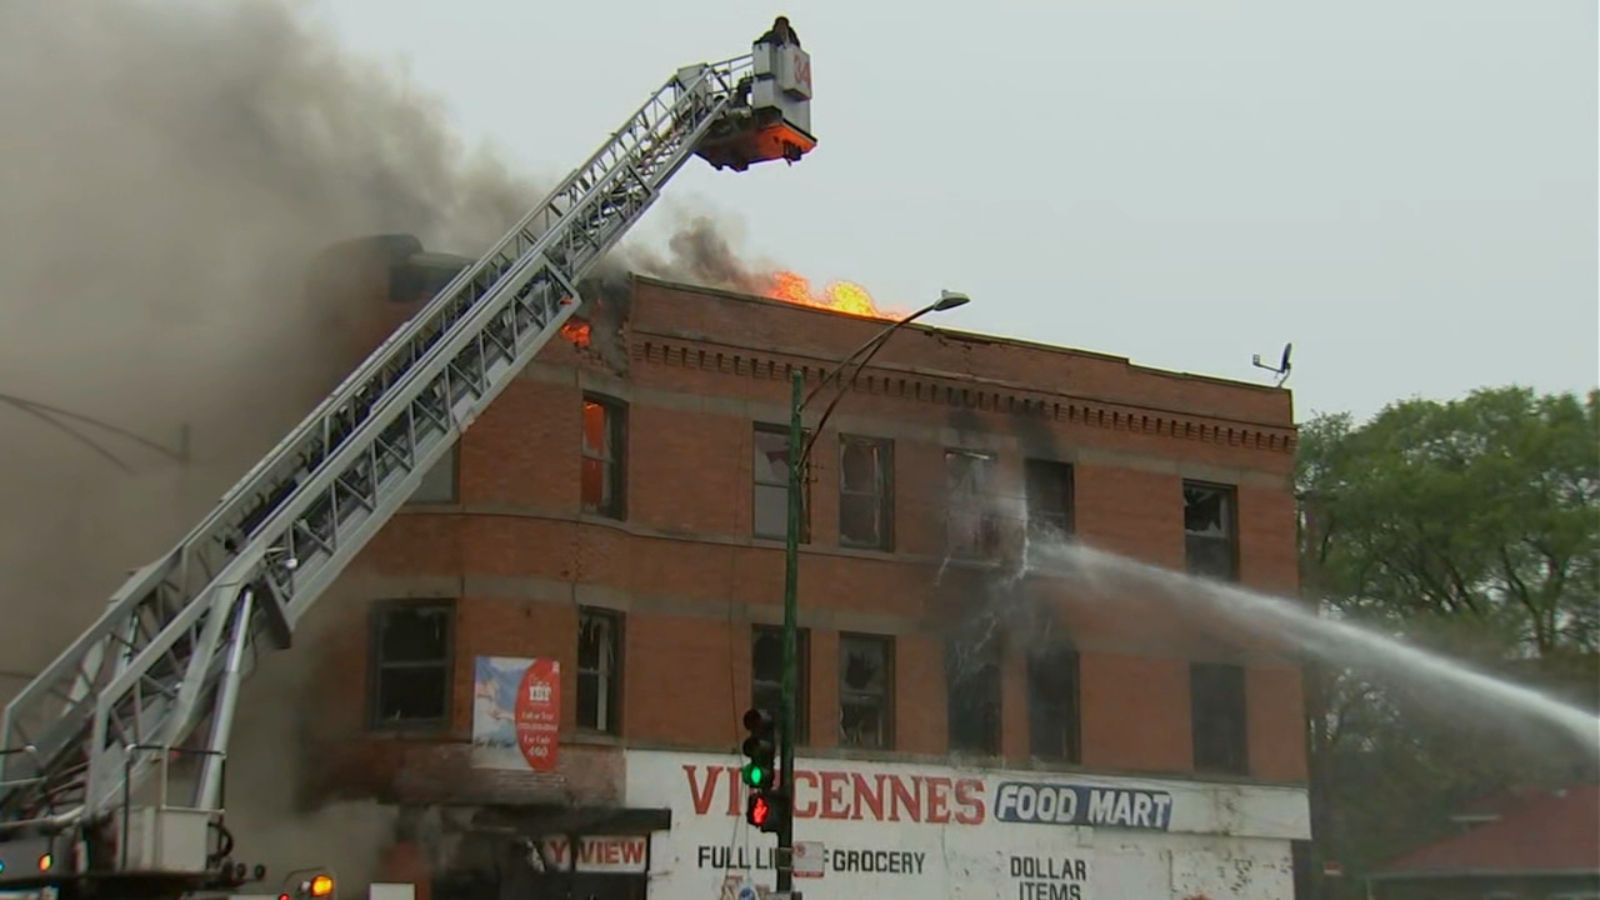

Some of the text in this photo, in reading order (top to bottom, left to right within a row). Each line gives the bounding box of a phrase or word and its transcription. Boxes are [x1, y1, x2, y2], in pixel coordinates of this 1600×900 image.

[683, 765, 985, 825] VICENNES
[998, 785, 1170, 828] FOOD MART
[577, 840, 644, 864] VIEW
[698, 846, 751, 869] FULL
[833, 850, 926, 874] GROCERY
[1010, 856, 1087, 881] DOLLAR
[1020, 882, 1081, 900] ITEMS
